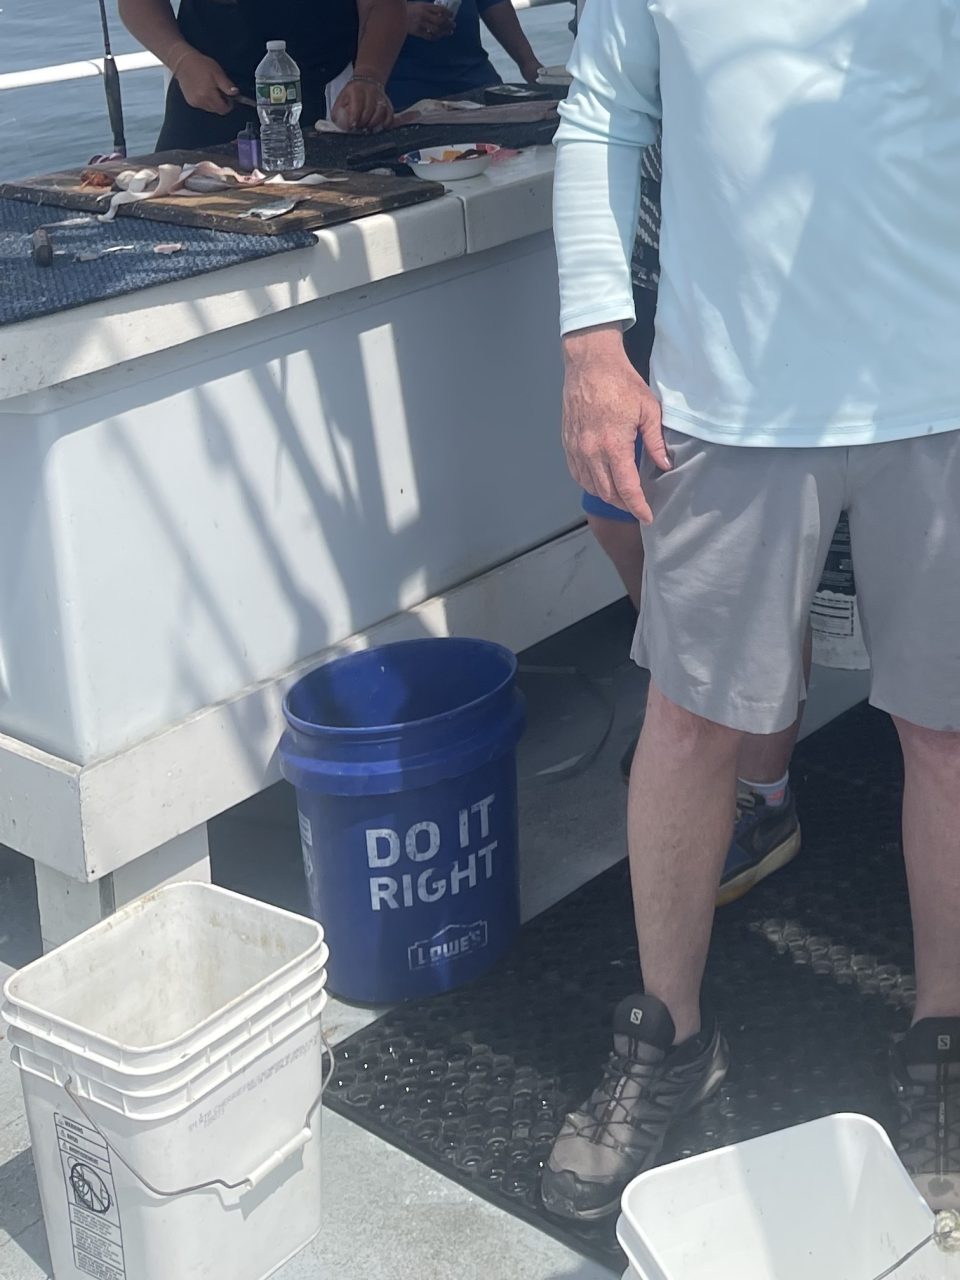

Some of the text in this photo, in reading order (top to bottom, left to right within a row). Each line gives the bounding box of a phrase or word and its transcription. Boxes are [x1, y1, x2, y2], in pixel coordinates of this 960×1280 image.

[364, 818, 441, 869] DO
[457, 793, 496, 849] IT
[368, 840, 500, 912] RIGHT
